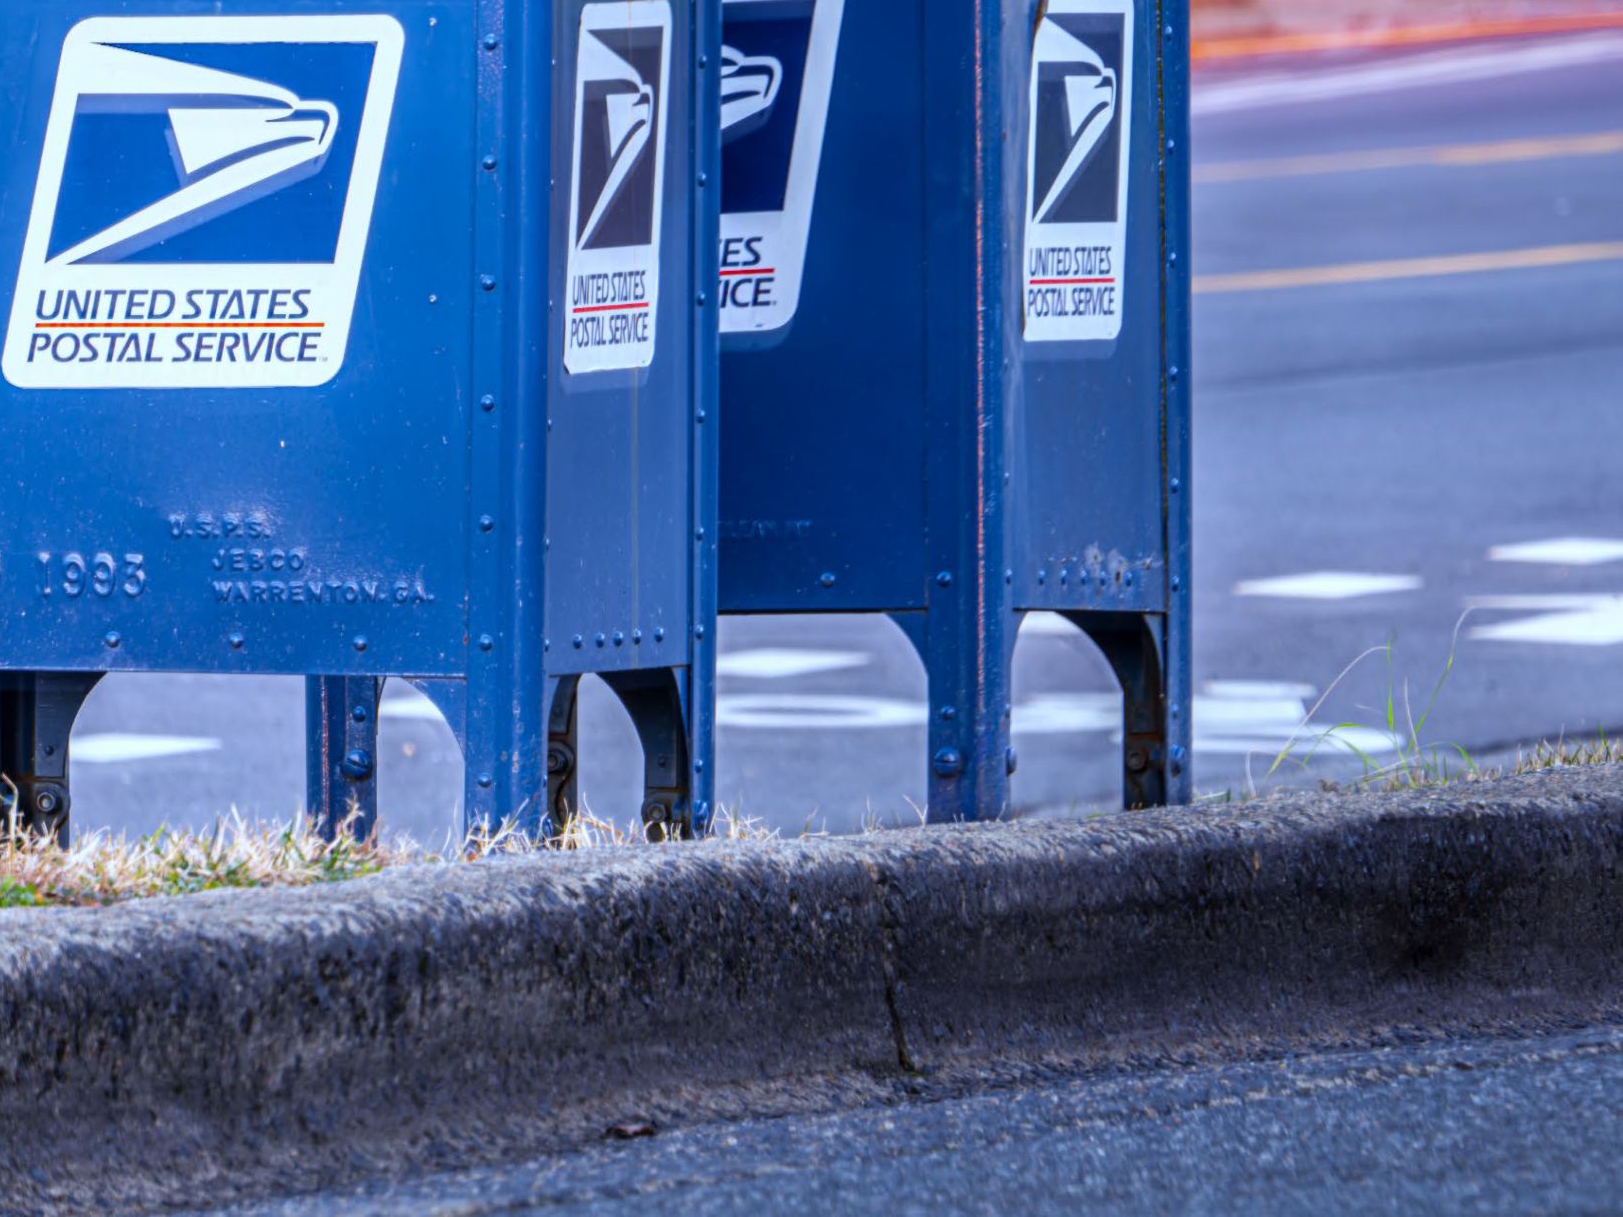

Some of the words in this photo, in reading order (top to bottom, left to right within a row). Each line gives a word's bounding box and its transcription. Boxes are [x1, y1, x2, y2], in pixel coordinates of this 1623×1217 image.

[1028, 246, 1072, 276] UNITED
[1072, 245, 1112, 275] STATES
[572, 272, 609, 305] UNITED
[610, 270, 646, 303] STATES
[1027, 287, 1069, 317] POSTAL
[1071, 286, 1115, 316] SERVICE
[35, 289, 176, 320] UNITED
[181, 288, 311, 320] STATES
[570, 316, 606, 349] POSTAL
[608, 311, 649, 345] SERVICE
[27, 333, 163, 363] POSTAL
[171, 332, 321, 363] SERVICE
